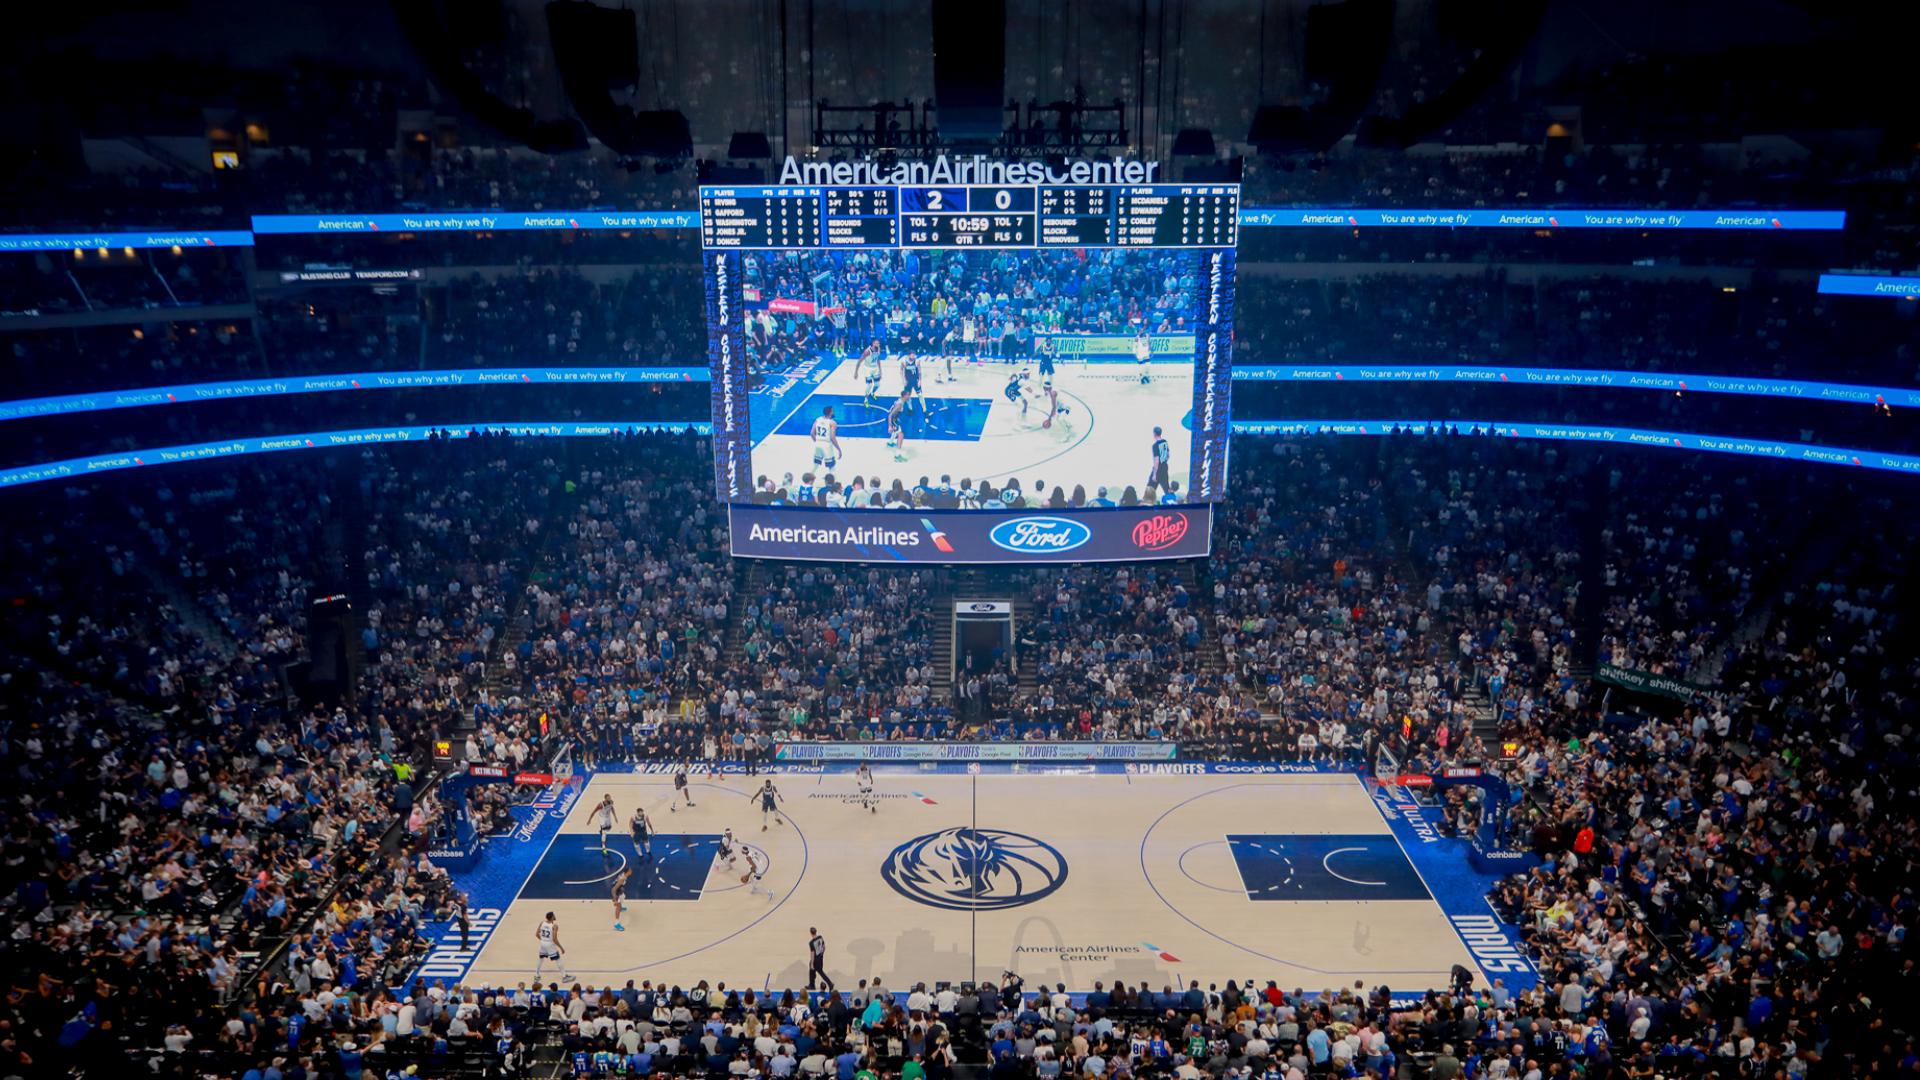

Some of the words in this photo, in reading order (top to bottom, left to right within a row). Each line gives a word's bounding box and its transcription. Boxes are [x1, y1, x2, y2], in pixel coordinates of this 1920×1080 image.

[927, 191, 942, 209] 2
[996, 191, 1011, 209] 0
[319, 220, 364, 229] American
[404, 219, 421, 227] You
[443, 219, 463, 229] why
[482, 218, 494, 228] fly
[524, 217, 565, 226] American
[602, 217, 619, 225] You
[639, 217, 658, 227] why
[676, 216, 688, 226] fly
[910, 218, 926, 226] TOL
[932, 218, 938, 226] 7
[950, 218, 989, 231] 10:59
[995, 218, 1011, 226] TOL
[1016, 218, 1022, 226] 7
[1302, 215, 1343, 223] American
[1381, 214, 1398, 223] You
[1418, 215, 1437, 225] why
[1456, 214, 1468, 225] fly
[1500, 215, 1544, 223] American
[1626, 216, 1647, 226] why
[1669, 216, 1681, 226] fly
[1716, 216, 1765, 225] American
[911, 233, 926, 241] FLS
[932, 233, 938, 241] 0
[956, 236, 972, 244] QTR
[978, 236, 982, 244] 1
[995, 233, 1010, 241] FLS
[1016, 233, 1022, 241] 0
[716, 253, 730, 326] WESTERN
[1210, 252, 1223, 325] WESTERN
[580, 373, 597, 381] why
[614, 372, 625, 381] fly
[641, 371, 678, 379] American
[720, 334, 735, 432] CONFERENCE
[1203, 333, 1217, 432] CONFERENCE
[727, 441, 739, 498] FINALS
[1200, 440, 1213, 498] FINALS
[1152, 516, 1173, 532] Dr
[749, 523, 840, 544] American
[843, 526, 919, 547] Airlines
[1009, 521, 1071, 547] Ford
[1136, 521, 1184, 547] Pepper
[1600, 667, 1645, 686] shiftkey
[1650, 679, 1697, 699] shiftkey
[791, 746, 823, 758] PLAYOFFS
[869, 746, 901, 758] PLAYOFFS
[947, 746, 979, 758] PLAYOFFS
[1025, 746, 1057, 758] PLAYOFFS
[1104, 746, 1135, 758] PLAYOFFS
[785, 764, 825, 772] Pixel
[1139, 763, 1205, 775] PLAYOFFS
[1215, 764, 1276, 774] Google
[1280, 764, 1318, 773] Pixel
[1403, 810, 1438, 844] ULTRA
[428, 850, 464, 858] coinbase
[1486, 851, 1522, 859] coinbase
[416, 908, 501, 977] DALLAS
[1451, 915, 1530, 972] MAVS
[1016, 945, 1084, 953] American
[1086, 945, 1140, 953] Airlines
[1060, 953, 1109, 961] Center
